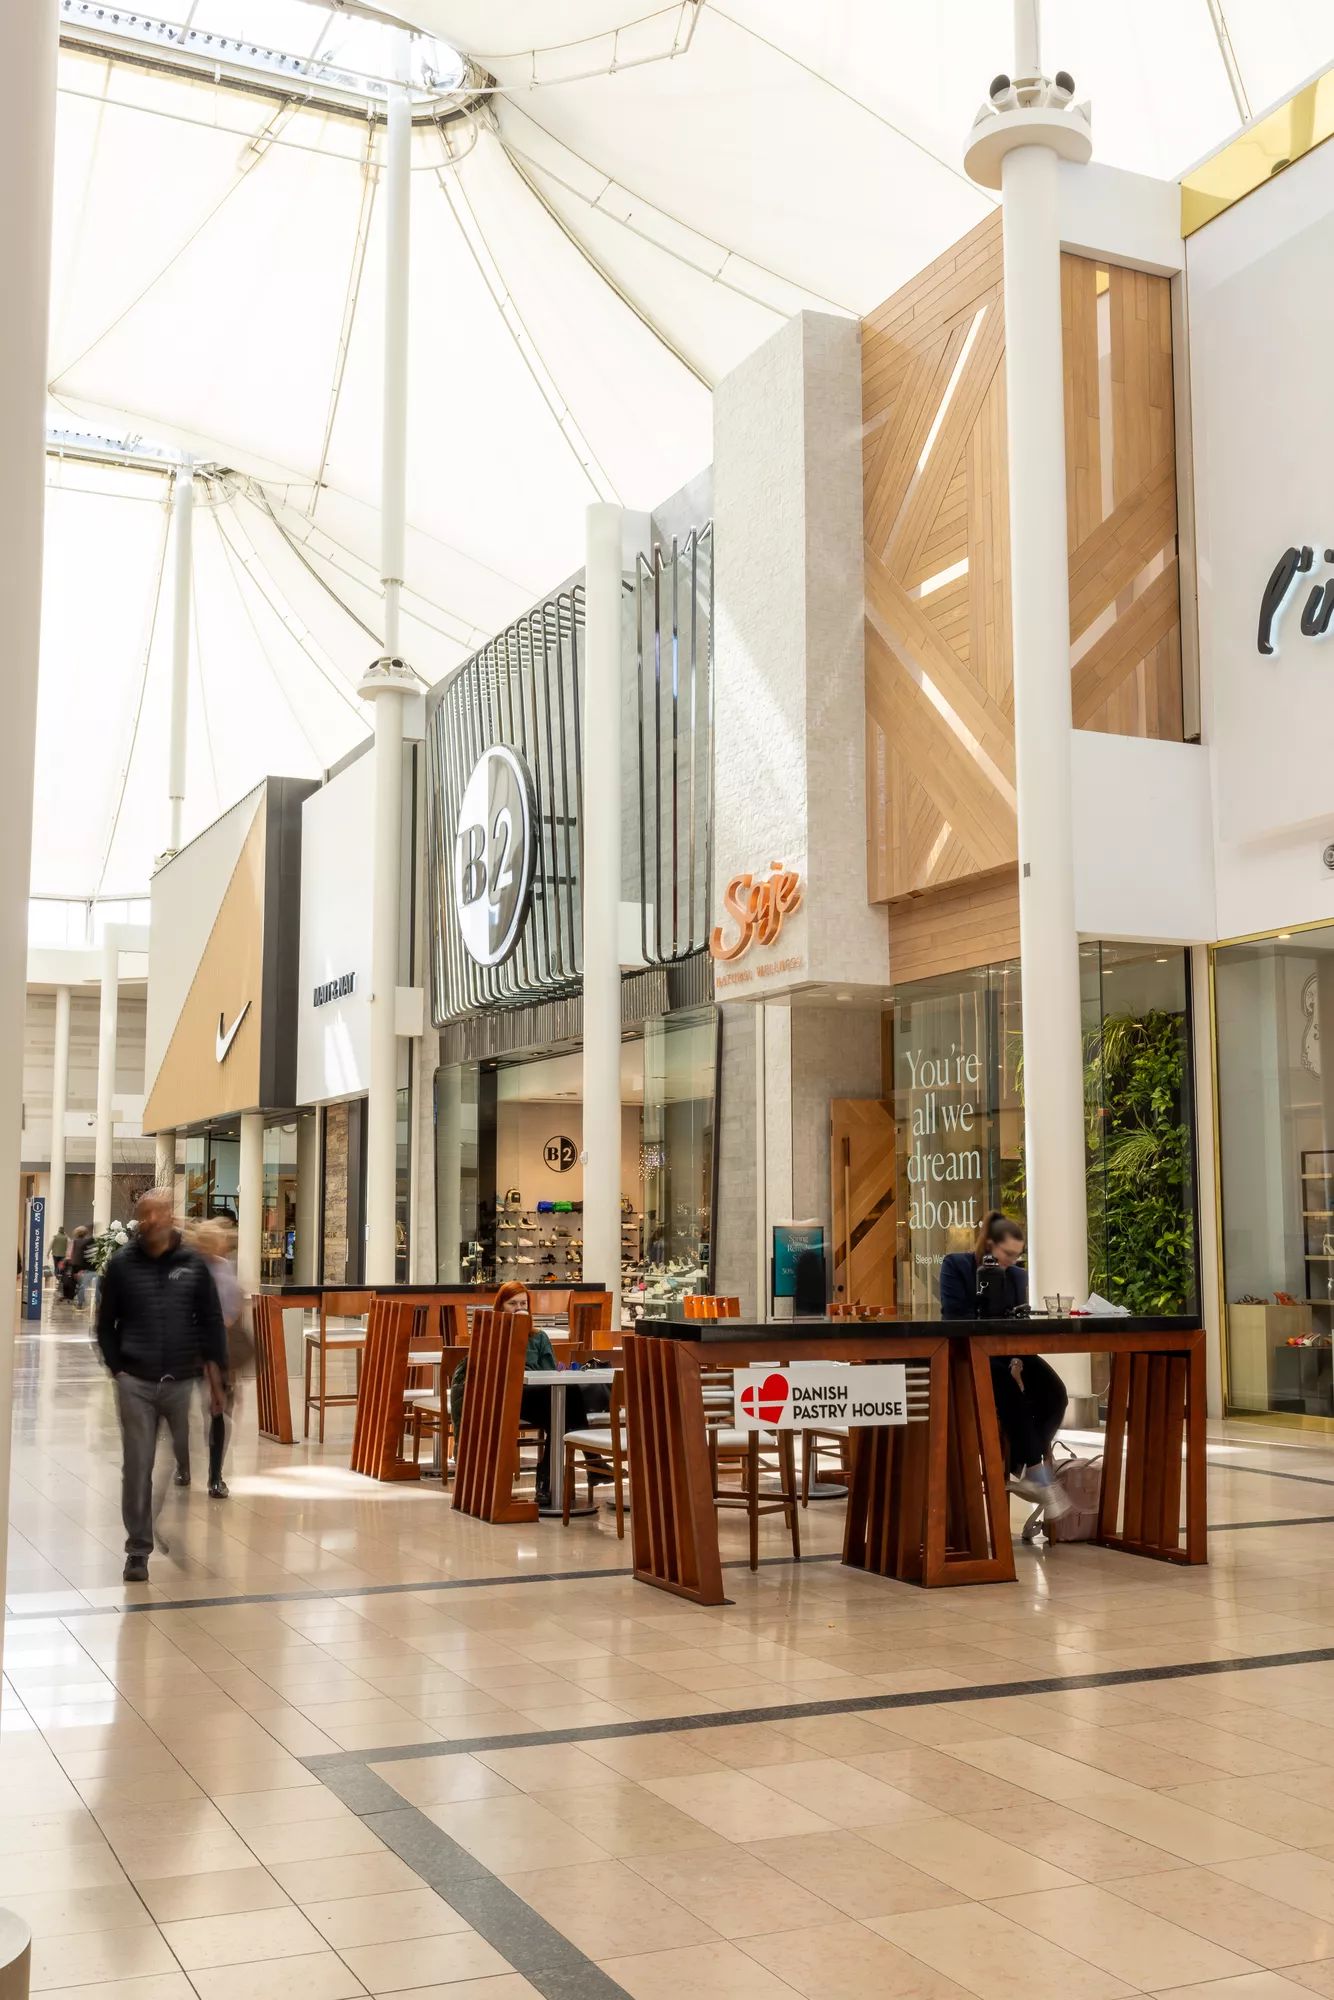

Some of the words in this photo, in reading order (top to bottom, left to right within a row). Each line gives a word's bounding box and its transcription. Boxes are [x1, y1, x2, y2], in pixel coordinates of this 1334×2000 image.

[458, 806, 513, 909] B2
[710, 860, 803, 960] Saje
[906, 1043, 980, 1089] You're
[912, 1092, 936, 1136] all
[941, 1102, 974, 1132] we
[546, 1146, 572, 1161] B2
[907, 1140, 981, 1184] dream
[909, 1187, 984, 1230] about.
[792, 1385, 848, 1401] DANISH
[793, 1404, 848, 1420] PASTRY
[852, 1402, 904, 1417] HOUSE
